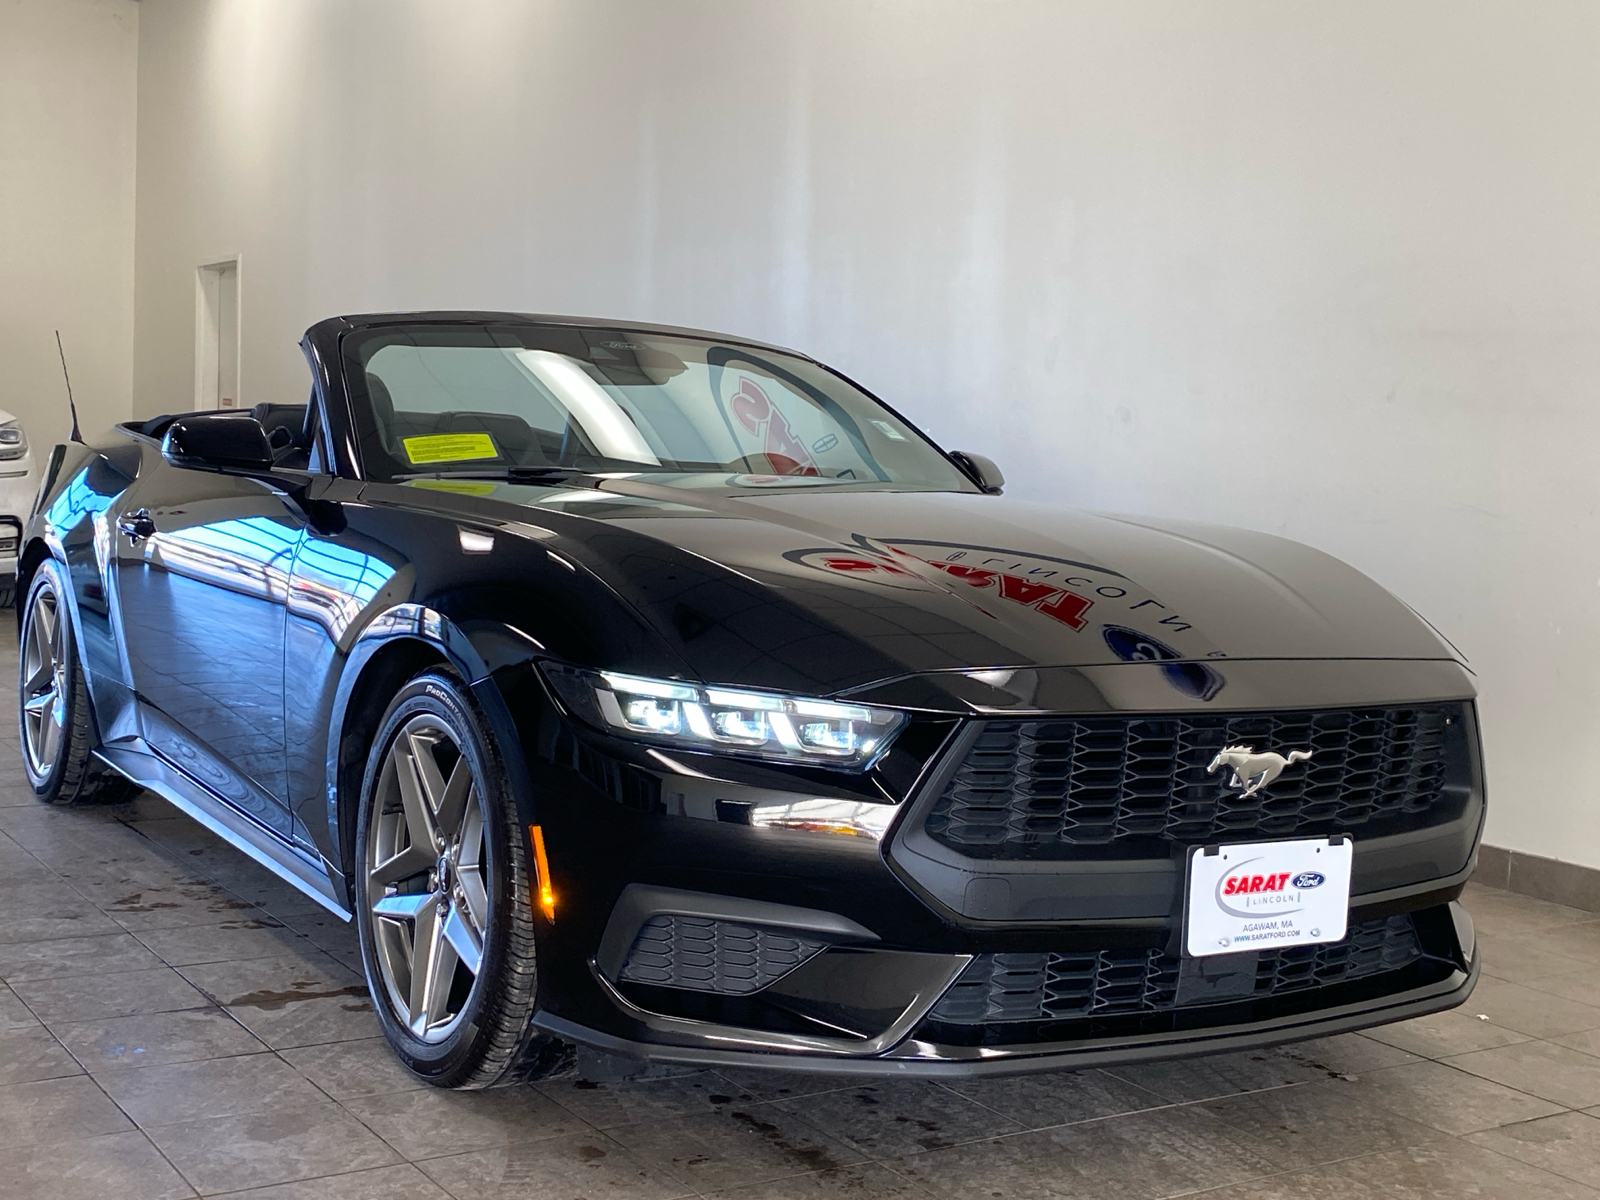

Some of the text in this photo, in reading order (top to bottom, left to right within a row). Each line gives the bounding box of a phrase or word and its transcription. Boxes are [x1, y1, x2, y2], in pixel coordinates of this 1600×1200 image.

[1223, 872, 1320, 896] SARAT Ford
[1253, 894, 1294, 905] LINCOLN
[1242, 920, 1293, 932] AGAWAM, MA
[1234, 930, 1300, 943] WWW.SARATFORD.COM
